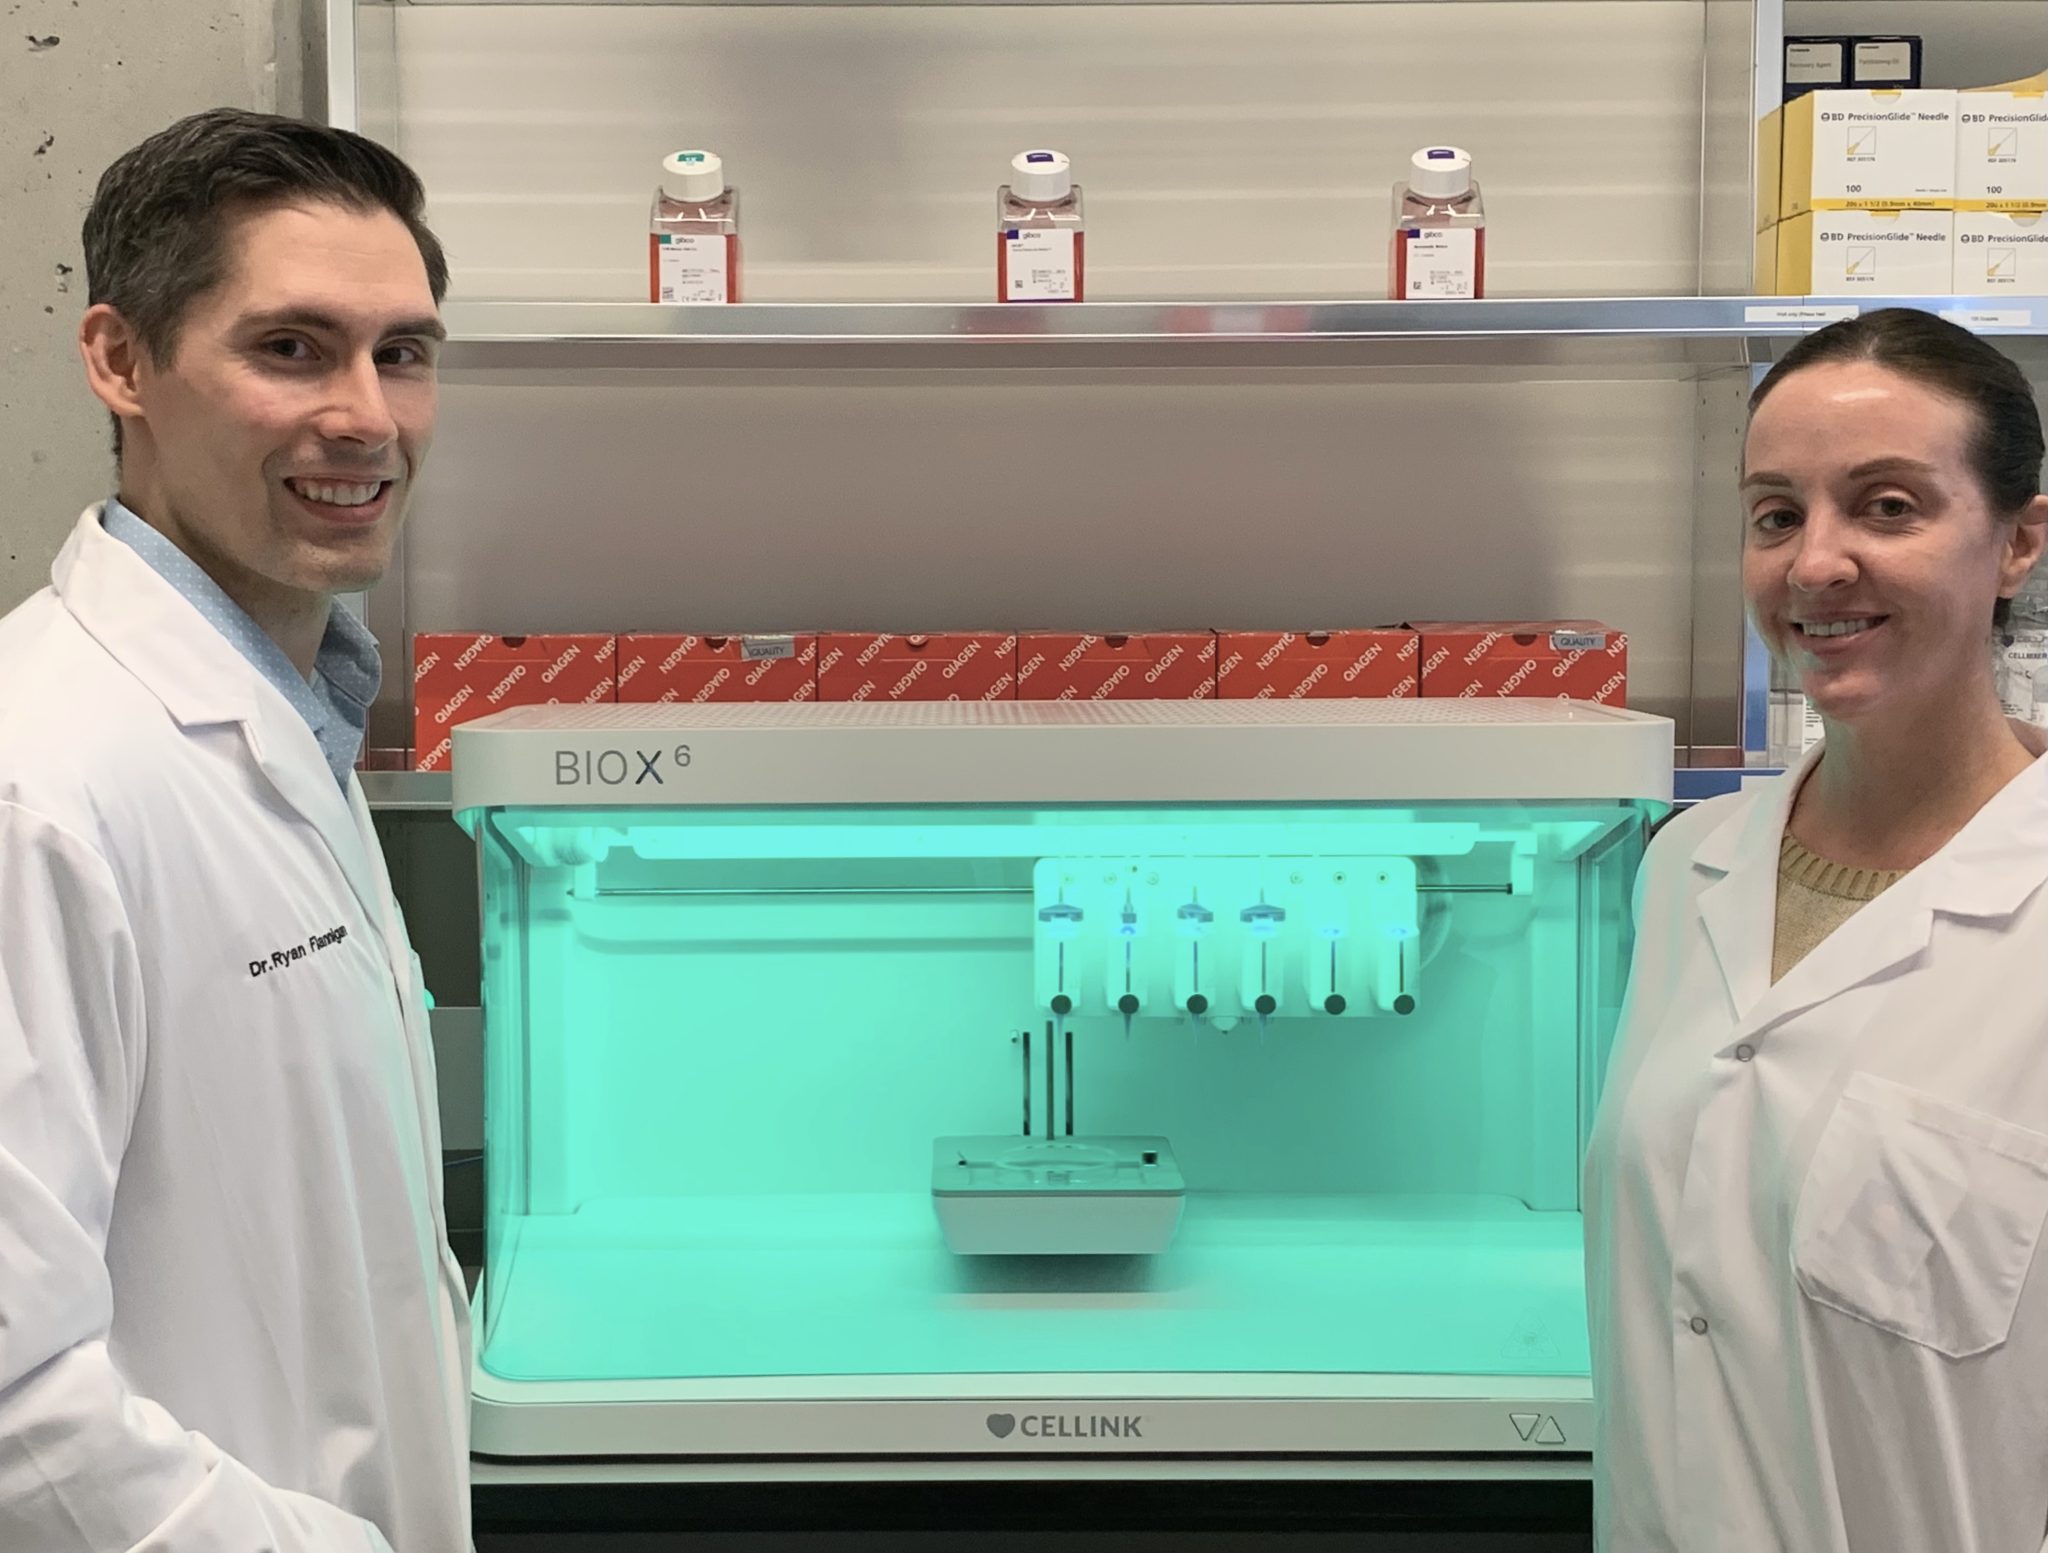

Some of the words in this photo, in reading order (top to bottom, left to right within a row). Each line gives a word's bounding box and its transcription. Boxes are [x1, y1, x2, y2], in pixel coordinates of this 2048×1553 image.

[1832, 113, 1845, 121] BD
[1918, 112, 1949, 121] Needle
[1972, 114, 1985, 122] BD
[1989, 113, 2048, 122] PrecisionGlid
[1845, 185, 1861, 193] 100
[1986, 186, 2002, 194] 100
[675, 237, 695, 245] gibco
[1424, 231, 1442, 239] gibco
[1831, 233, 1844, 241] BD
[1916, 233, 1946, 241] Needle
[1971, 234, 1984, 243] BD
[594, 636, 616, 663] GEN
[752, 645, 785, 657] QUALITY
[797, 642, 817, 665] GEN
[994, 635, 1017, 659] GEN
[1197, 640, 1216, 663] GEN
[1396, 636, 1419, 662] GEN
[1560, 636, 1596, 647] QUALITY
[1606, 634, 1628, 658] GEN
[415, 652, 441, 683] AGEN
[541, 644, 581, 684] QIAGEN
[659, 636, 698, 674] QIAGEN
[818, 647, 844, 679] AGEN
[942, 640, 982, 680] QIAGEN
[1144, 644, 1184, 684] QIAGEN
[1343, 643, 1383, 683] QIAGEN
[1422, 646, 1450, 679] AGEN
[617, 655, 646, 688] AGEN
[888, 660, 928, 700] QIAGEN
[1017, 653, 1046, 685] AGEN
[1497, 659, 1537, 698] QIAGEN
[487, 664, 527, 704] QIAGEN
[434, 684, 474, 724] QIAGEN
[1020, 1414, 1143, 1438] CELLINK
